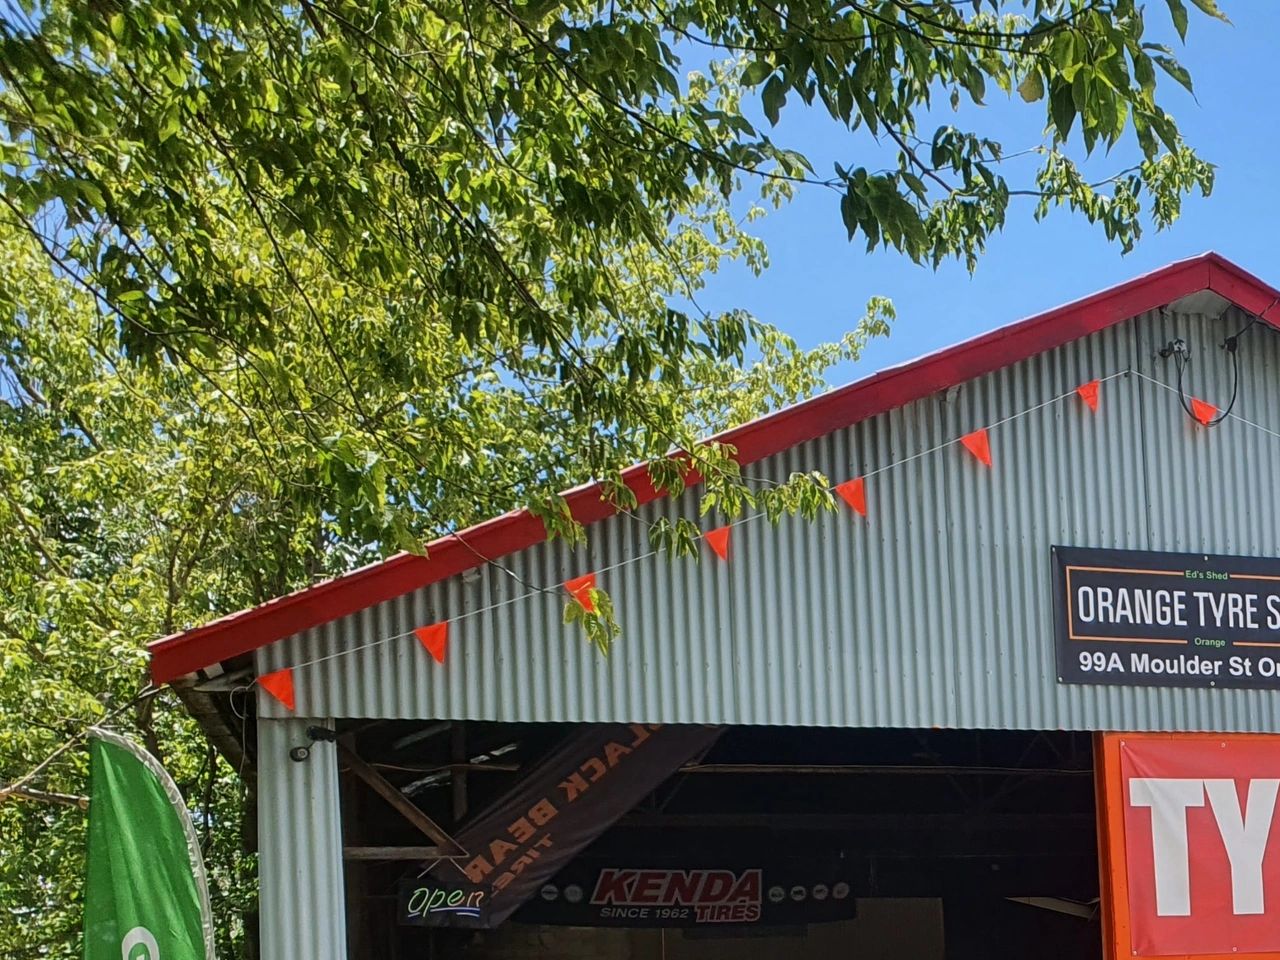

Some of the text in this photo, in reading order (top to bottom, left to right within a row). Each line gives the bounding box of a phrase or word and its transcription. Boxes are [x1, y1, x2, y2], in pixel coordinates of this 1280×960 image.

[1185, 570, 1228, 581] Ed's Shed
[1077, 585, 1188, 627] ORANGE
[1193, 591, 1259, 629] TYRE
[1194, 637, 1226, 649] Orange
[1079, 652, 1125, 674] 99A
[1131, 653, 1222, 677] Moulder
[1229, 656, 1252, 677] St
[590, 869, 763, 906] KENDA
[600, 903, 761, 923] SINCE 1962 TIRES
